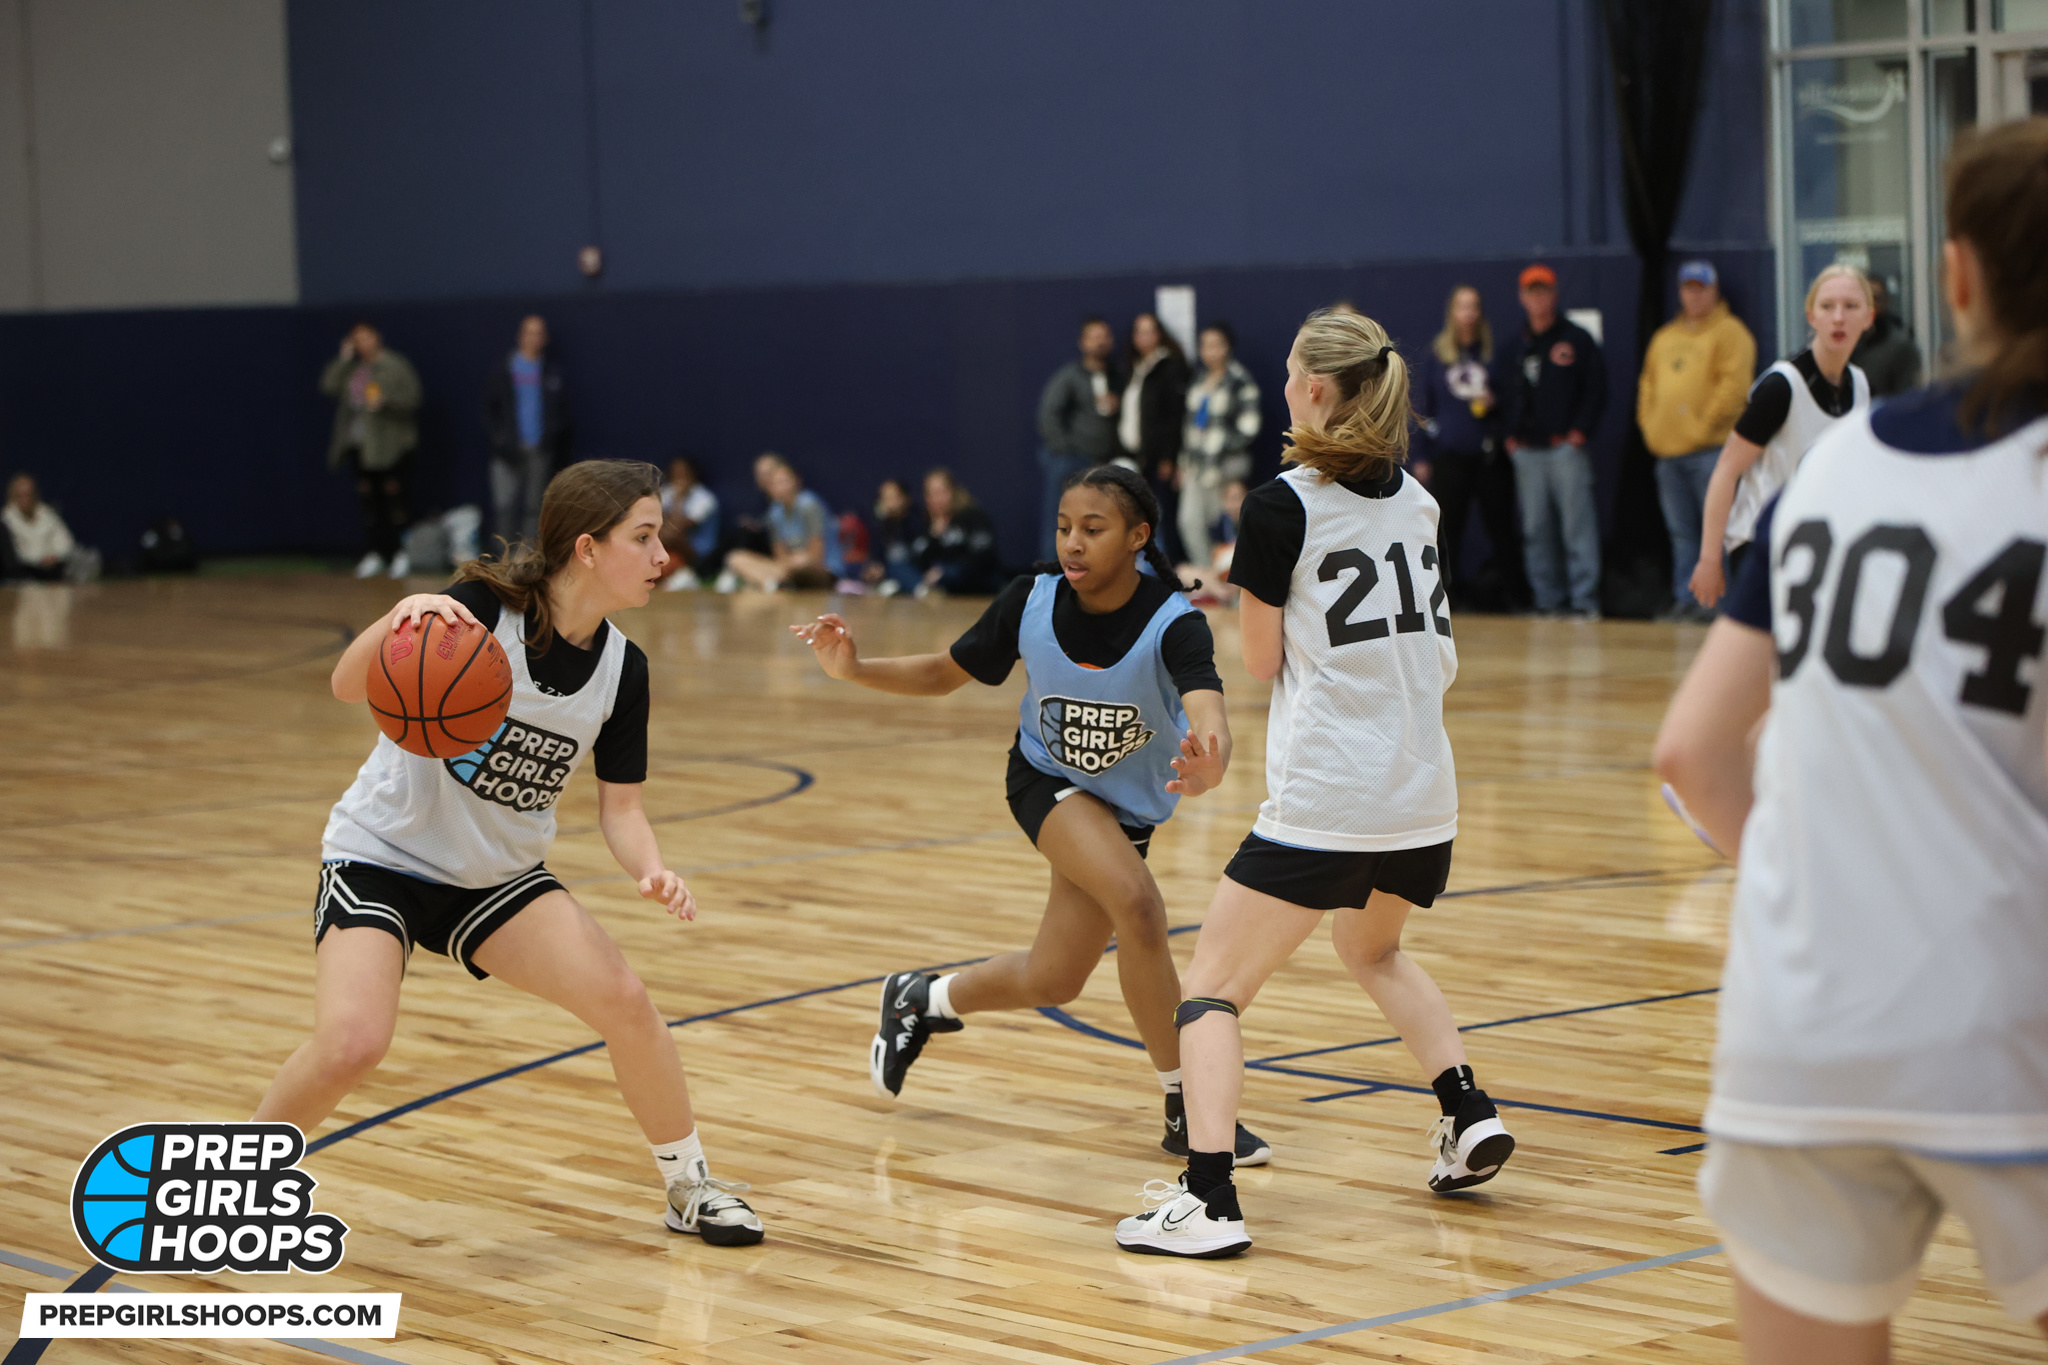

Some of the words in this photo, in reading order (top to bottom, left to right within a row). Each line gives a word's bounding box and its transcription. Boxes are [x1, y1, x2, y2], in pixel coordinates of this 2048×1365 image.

[1317, 542, 1452, 647] 212
[1779, 519, 2047, 718] 304
[1065, 704, 1134, 728] PREP
[501, 725, 574, 761] PREP
[1063, 724, 1138, 750] GIRLS
[1065, 732, 1147, 771] HOOPS
[488, 751, 565, 787] GIRLS
[473, 771, 560, 809] HOOPS
